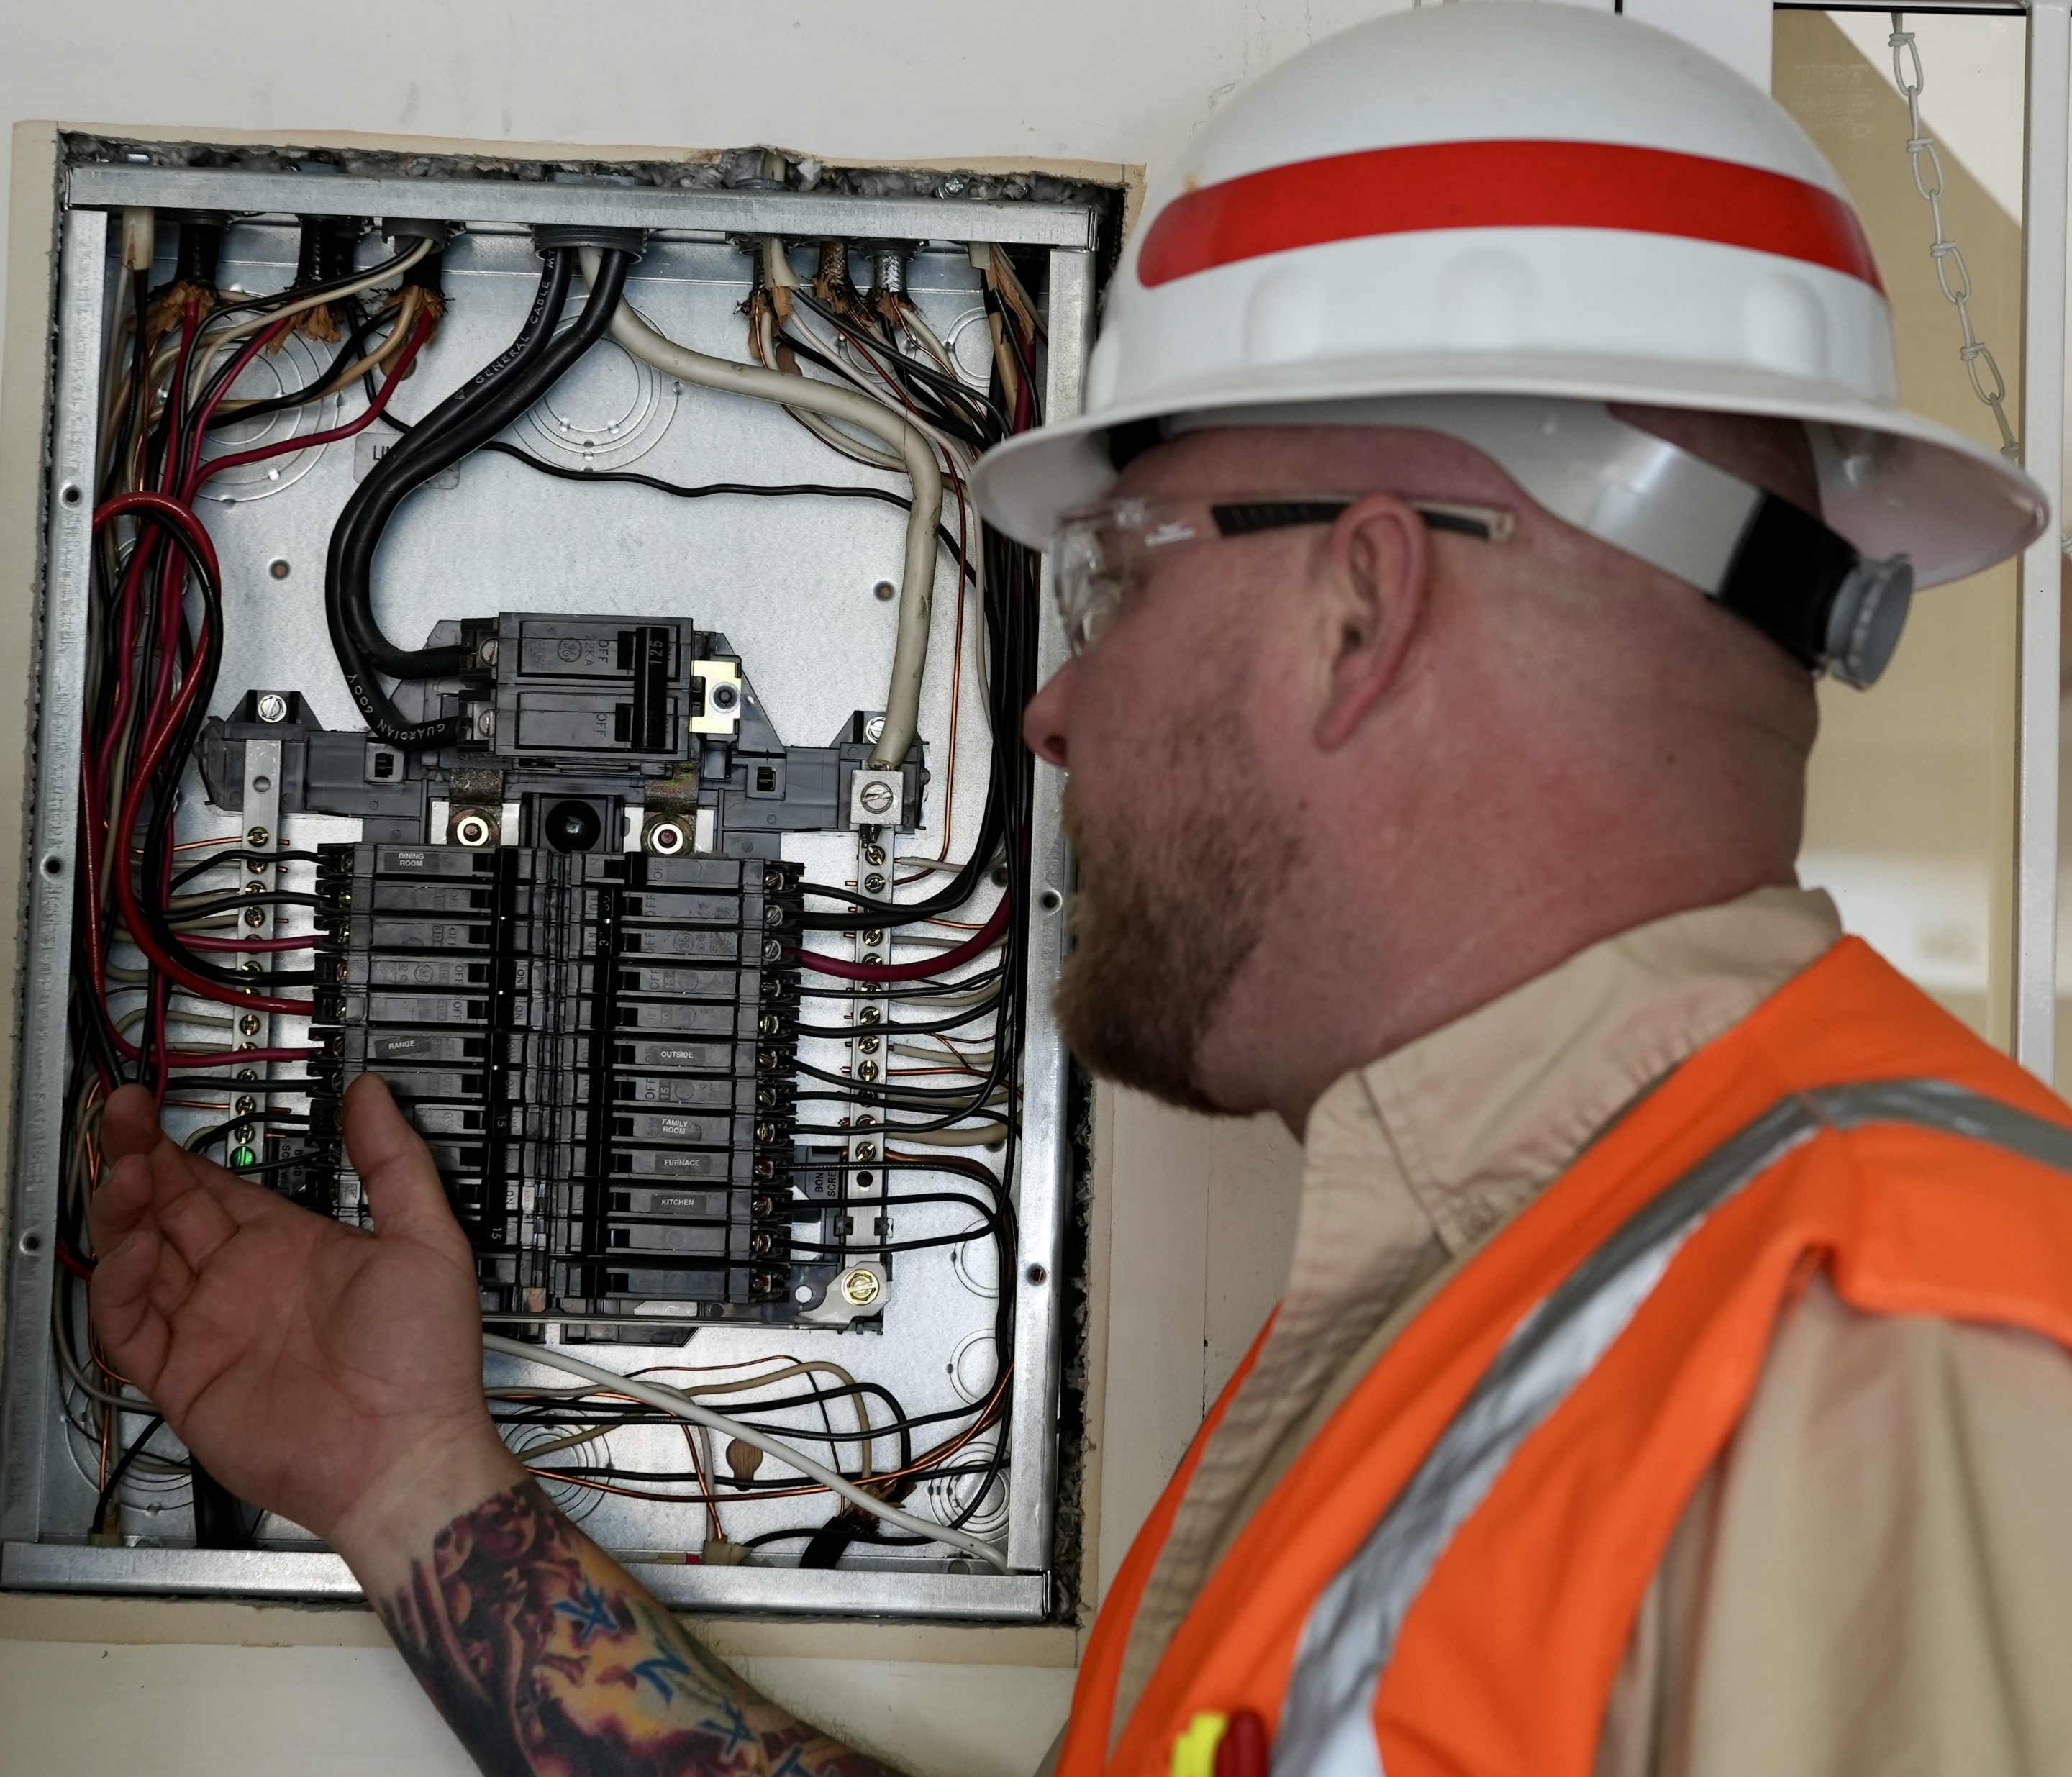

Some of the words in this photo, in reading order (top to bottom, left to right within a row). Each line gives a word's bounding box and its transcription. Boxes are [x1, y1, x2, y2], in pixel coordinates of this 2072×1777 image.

[475, 336, 530, 384] GENERAL
[530, 281, 551, 324] CABLE
[598, 640, 609, 663] OFF
[649, 640, 663, 665] 125
[377, 719, 445, 740] GUARDIAN
[596, 712, 608, 737] OFF
[455, 965, 464, 984] OFF
[517, 969, 525, 985] ON
[453, 1001, 462, 1021] OFF
[515, 1004, 524, 1020] ON
[388, 1040, 416, 1050] RANGE
[645, 1078, 655, 1100] OFF
[497, 1115, 506, 1127] 15
[661, 1119, 688, 1127] FAMILY
[663, 1126, 686, 1135] ROOM
[814, 1172, 824, 1192] BON
[827, 1171, 836, 1197] SCRE
[506, 1190, 514, 1205] ON
[491, 1227, 502, 1240] 15
